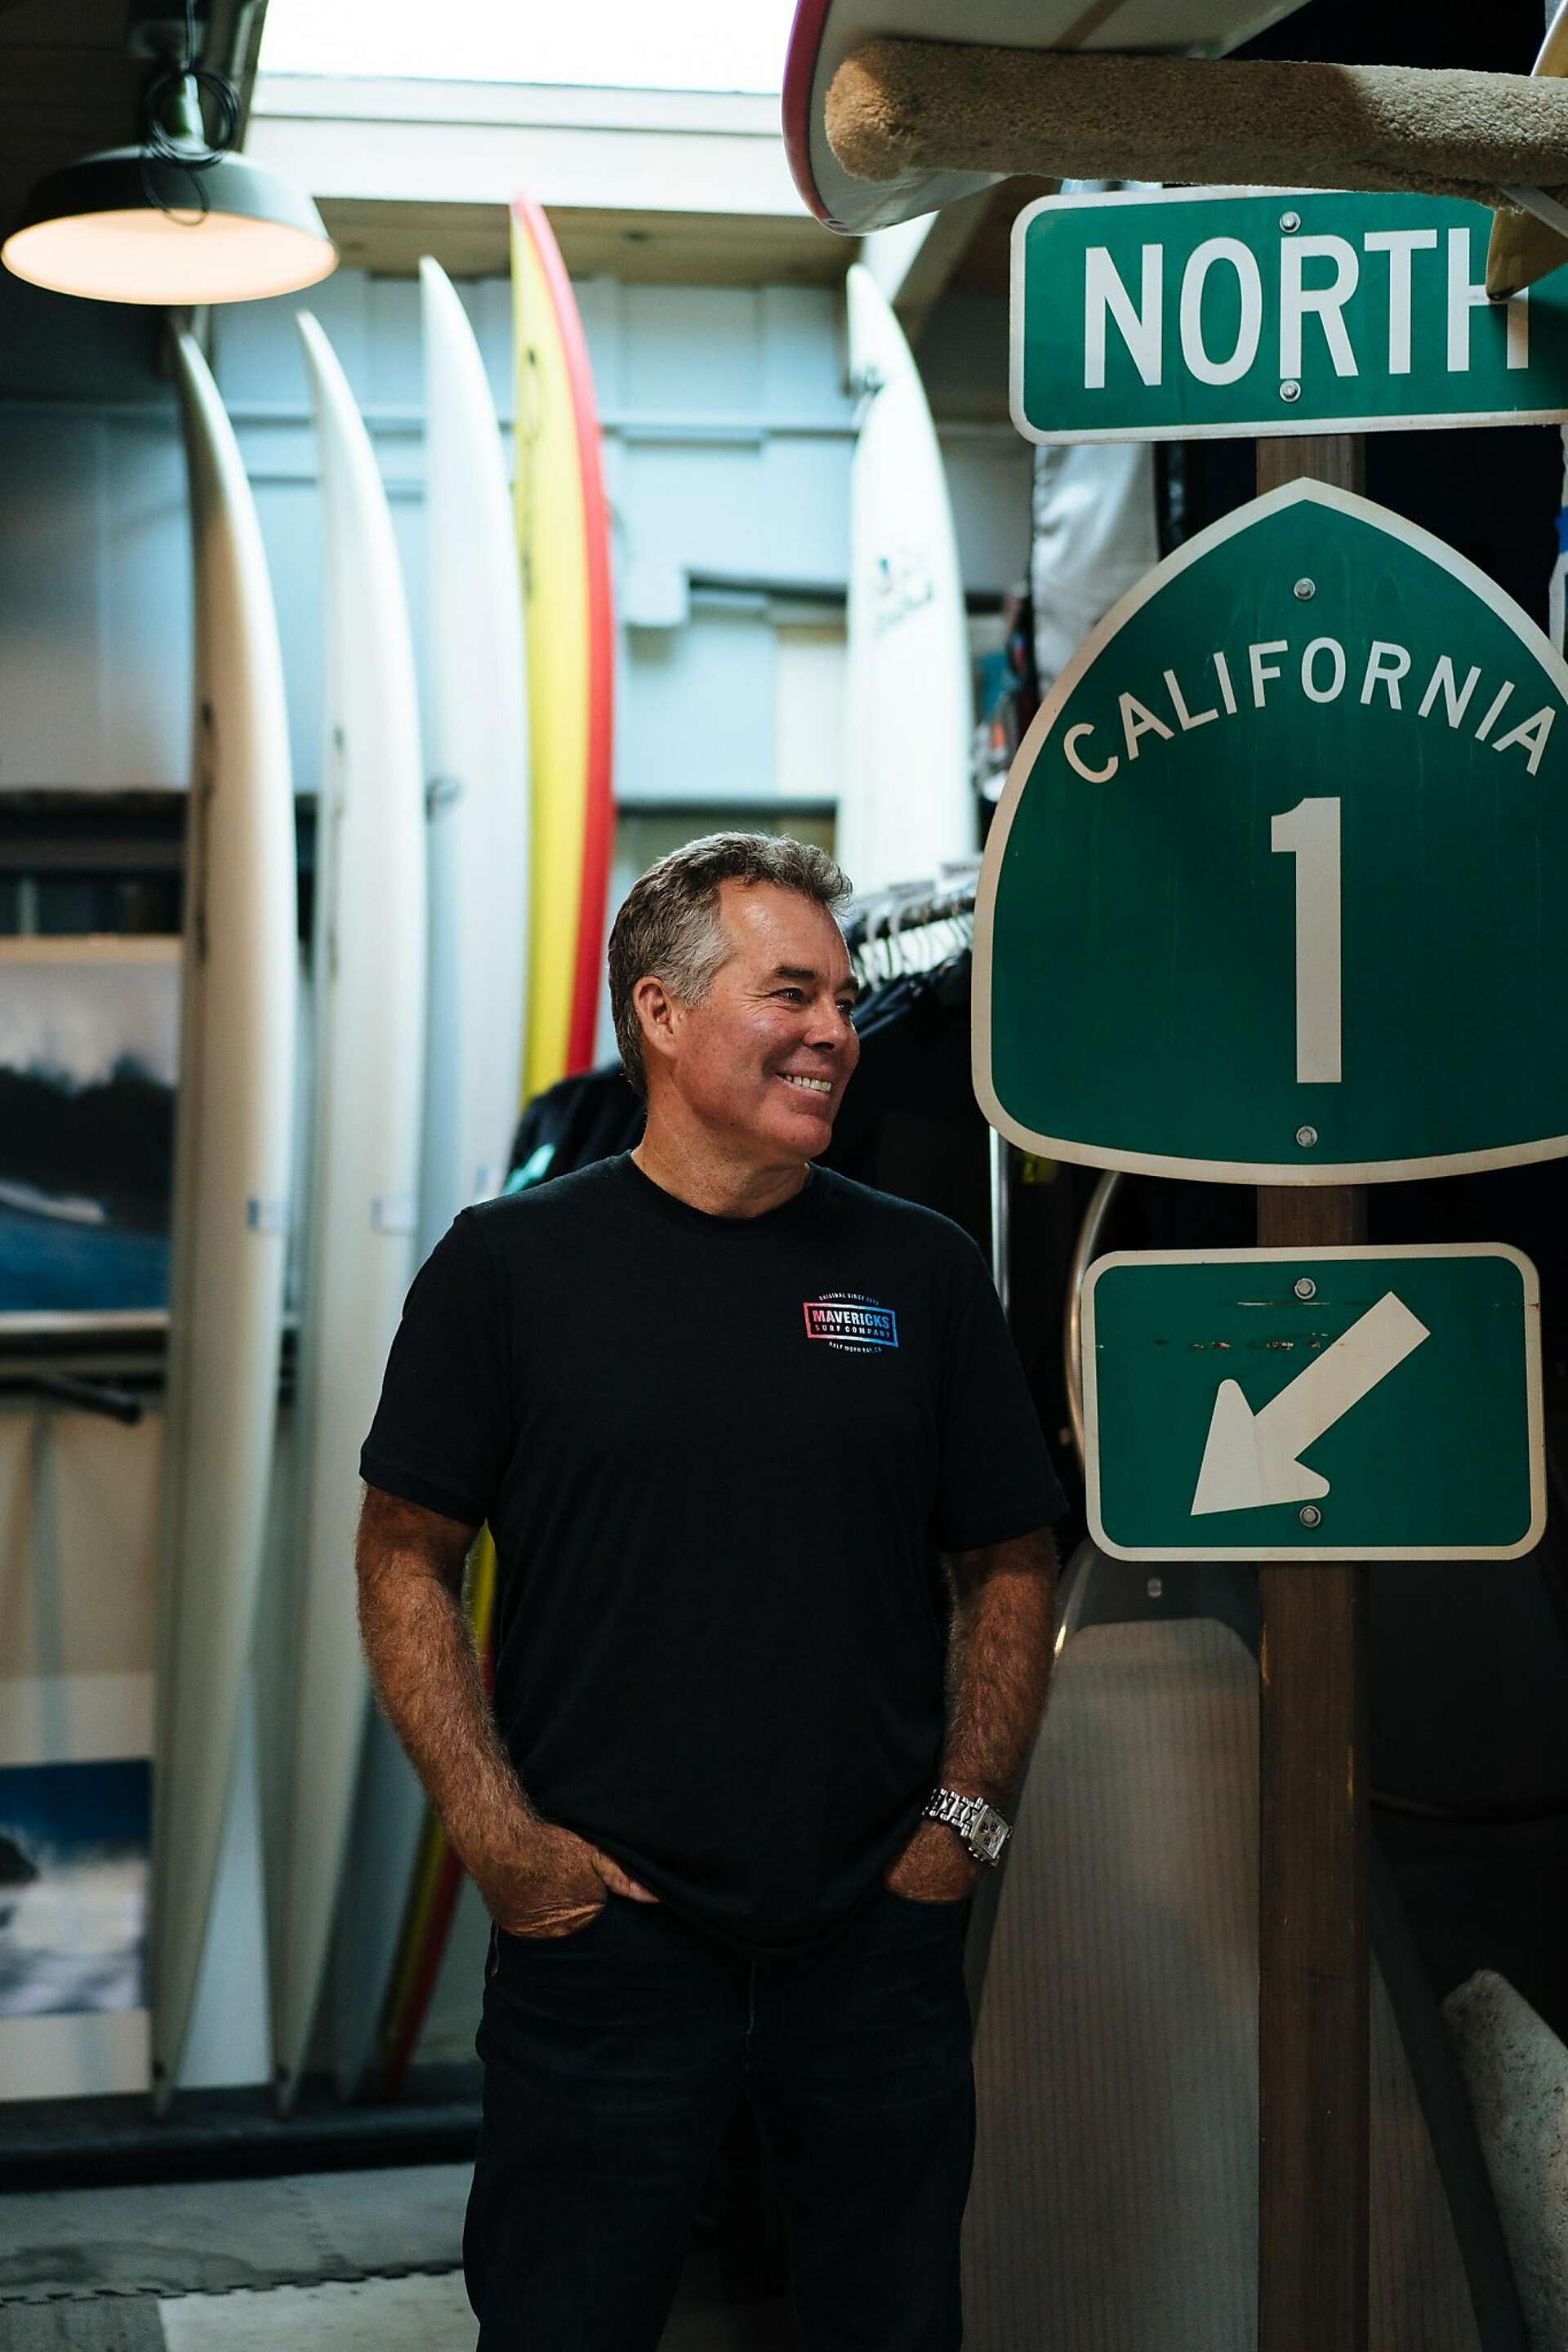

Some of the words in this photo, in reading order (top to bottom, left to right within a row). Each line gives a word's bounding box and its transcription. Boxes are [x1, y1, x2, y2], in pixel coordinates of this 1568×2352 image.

[1084, 228, 1530, 390] NORTH
[1062, 635, 1556, 785] CALIFORNIA
[1270, 796, 1343, 1085] 1
[812, 1310, 889, 1329] MAVERICKS
[828, 1341, 843, 1349] HALF
[845, 1326, 890, 1338] COMPANY
